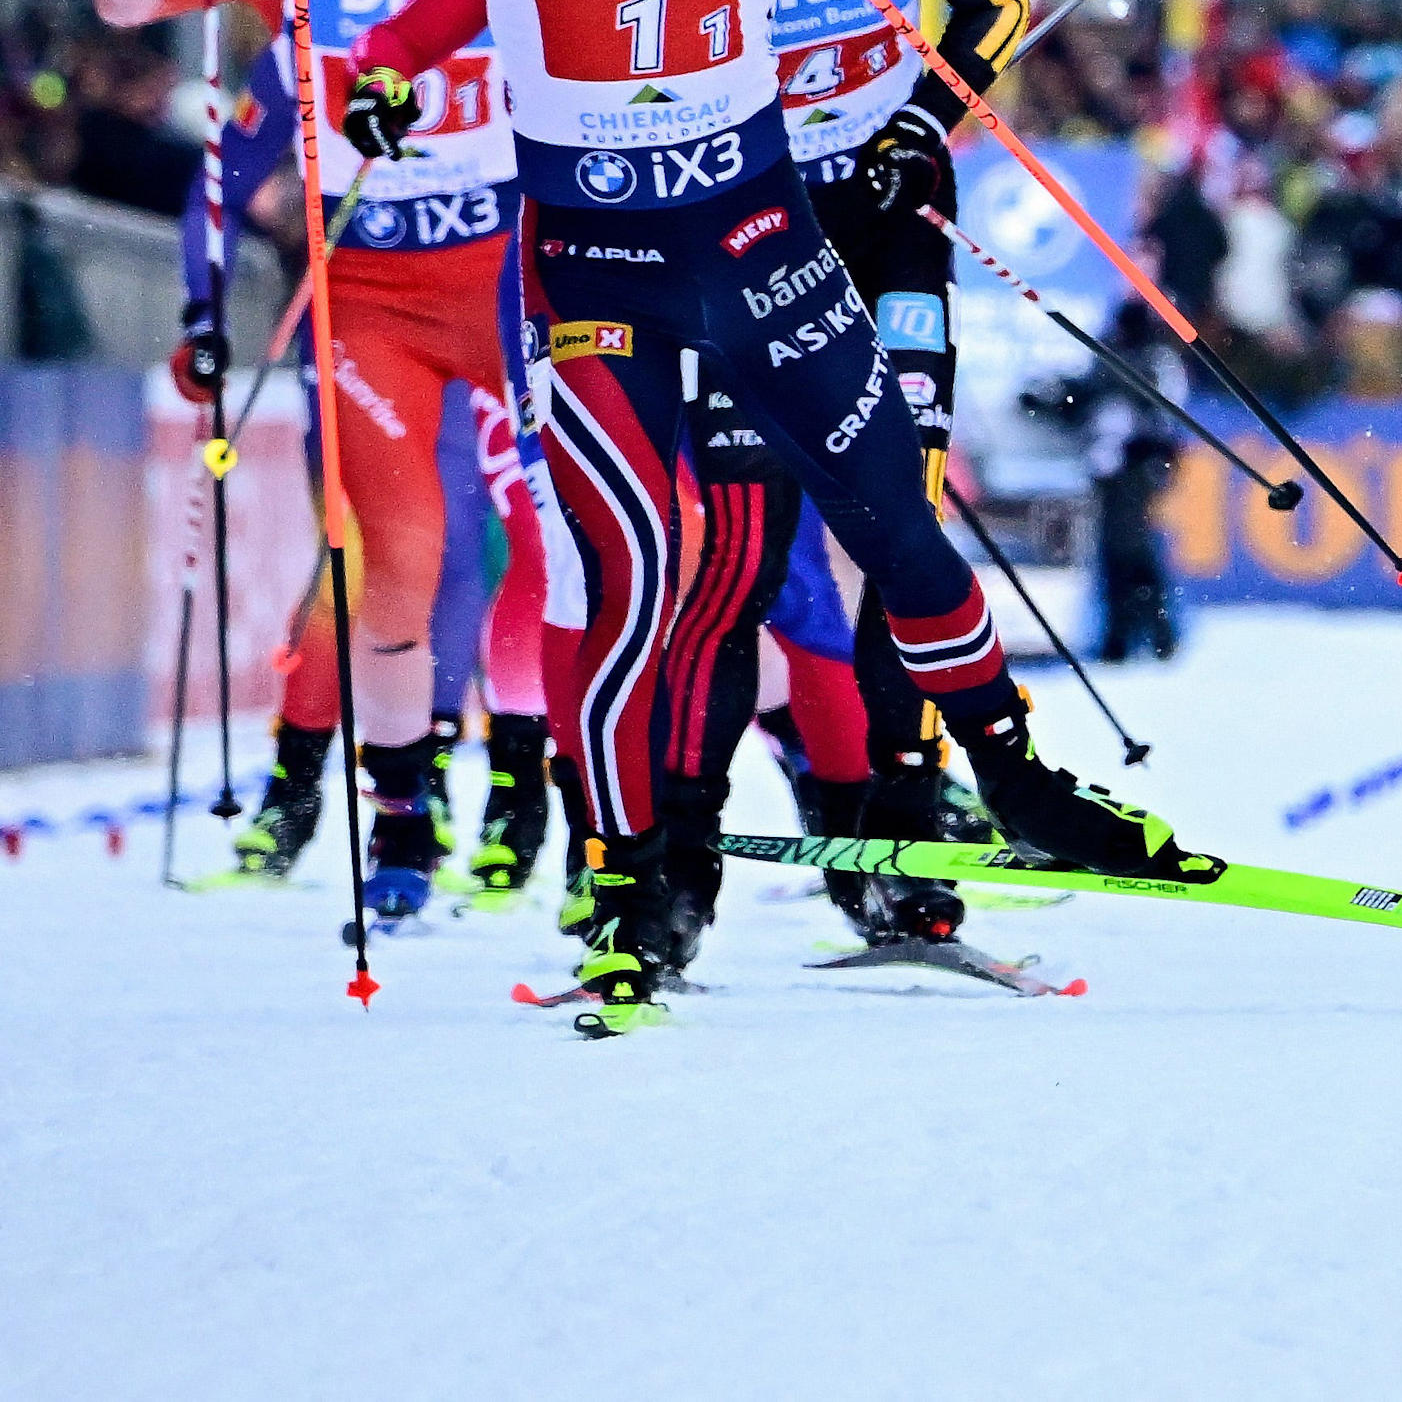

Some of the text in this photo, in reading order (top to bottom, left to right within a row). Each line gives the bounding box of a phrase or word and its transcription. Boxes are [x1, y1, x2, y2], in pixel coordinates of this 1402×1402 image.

[700, 5, 731, 59] 1
[780, 45, 845, 99] 4
[579, 95, 732, 130] CHIEMGAU
[653, 132, 745, 199] iX3
[414, 190, 500, 245] iX3
[729, 212, 783, 250] MENY
[555, 330, 591, 348] Uno
[825, 353, 888, 454] CRAFT
[1104, 877, 1188, 895] FISCHER
